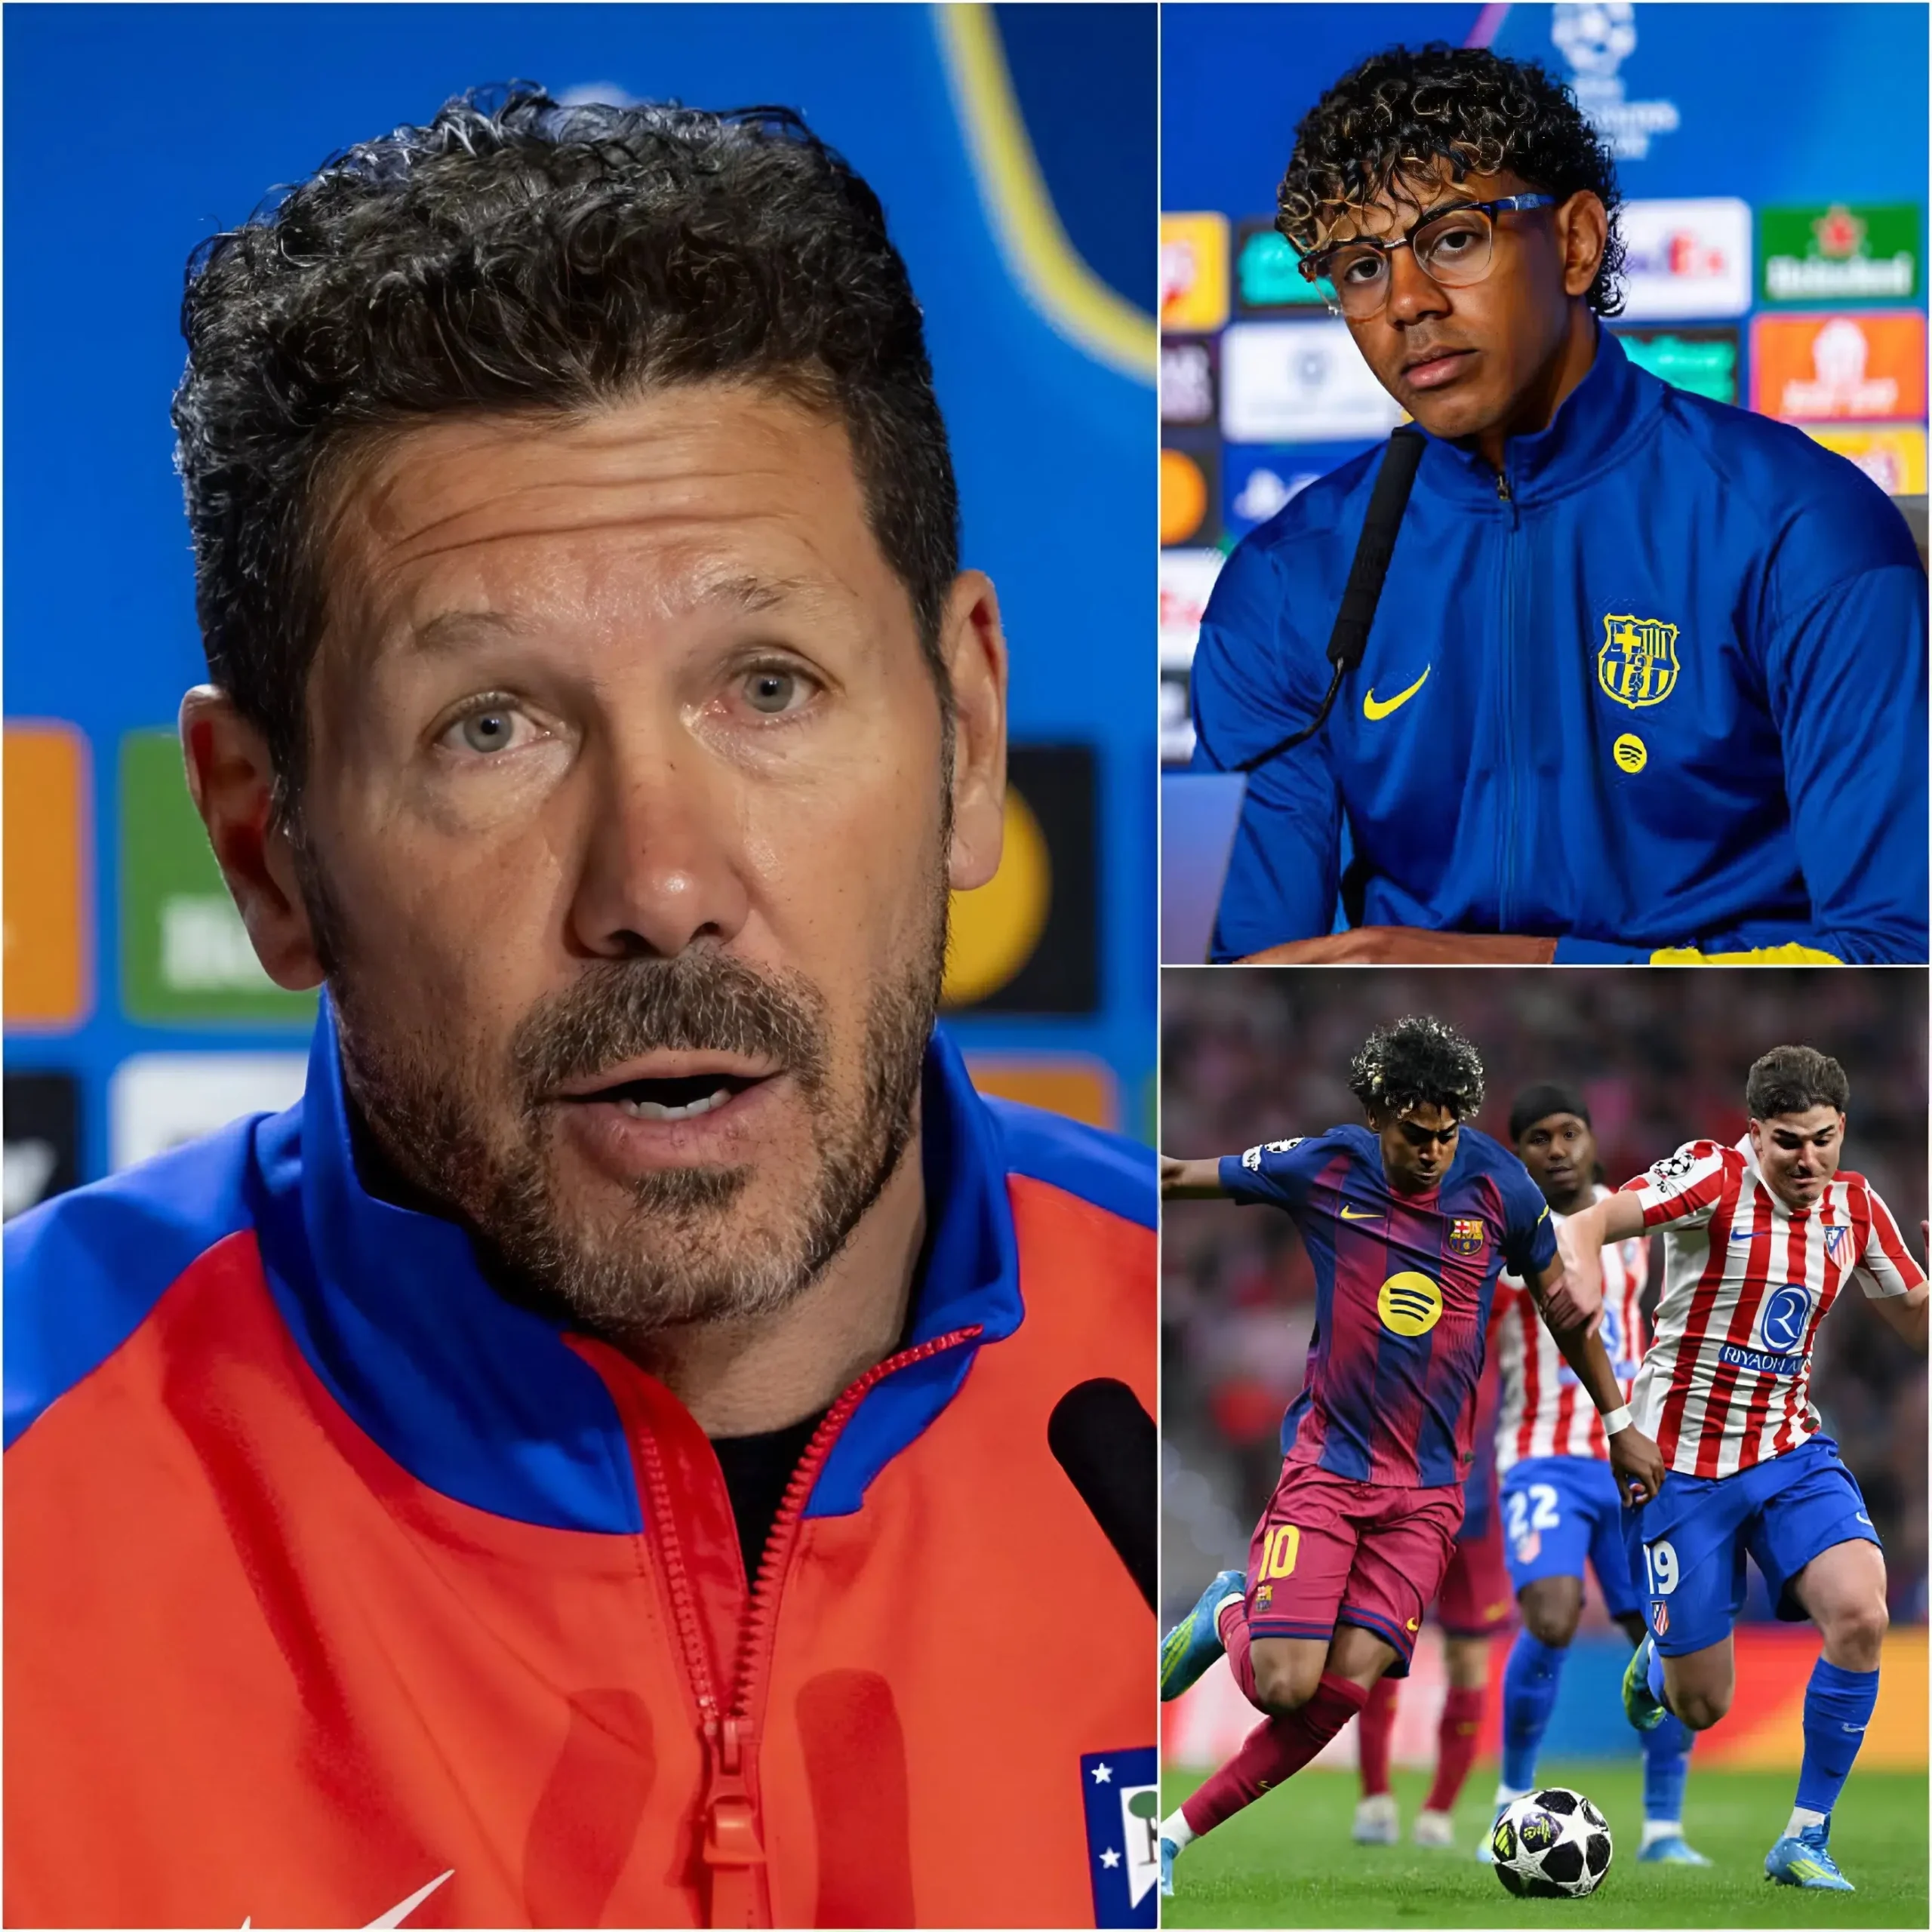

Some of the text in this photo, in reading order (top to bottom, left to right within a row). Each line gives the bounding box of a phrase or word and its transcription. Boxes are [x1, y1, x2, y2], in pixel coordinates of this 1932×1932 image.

[1724, 1346, 1786, 1372] RIYADH
[1508, 1483, 1560, 1540] 22
[1257, 1524, 1300, 1583] 10
[1643, 1540, 1679, 1595] 19
